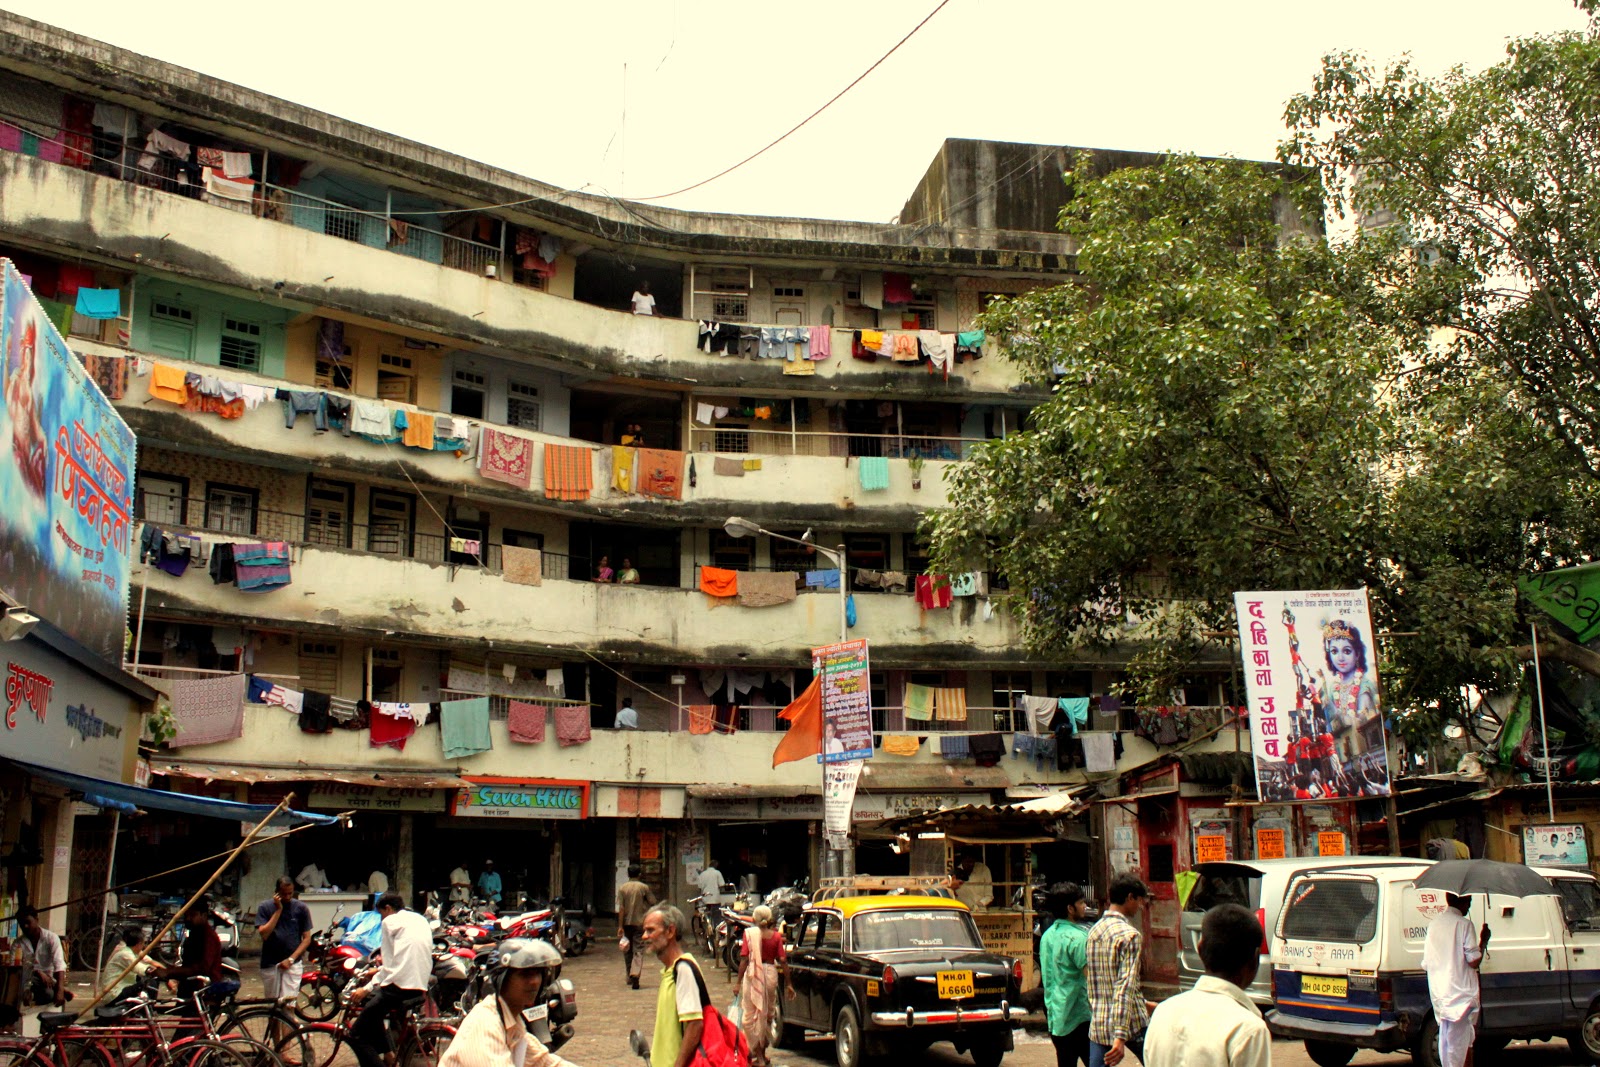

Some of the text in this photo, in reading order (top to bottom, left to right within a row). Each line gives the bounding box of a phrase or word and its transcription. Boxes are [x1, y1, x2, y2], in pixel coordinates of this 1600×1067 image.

[479, 785, 531, 806] Seven
[536, 787, 579, 809] Hills
[990, 932, 1011, 940] SARAF
[1014, 932, 1033, 940] TRUST
[1284, 946, 1354, 960] BRINK'S ARYA
[1301, 982, 1311, 992] MH
[1313, 983, 1320, 992] 04
[1322, 984, 1331, 993] CP
